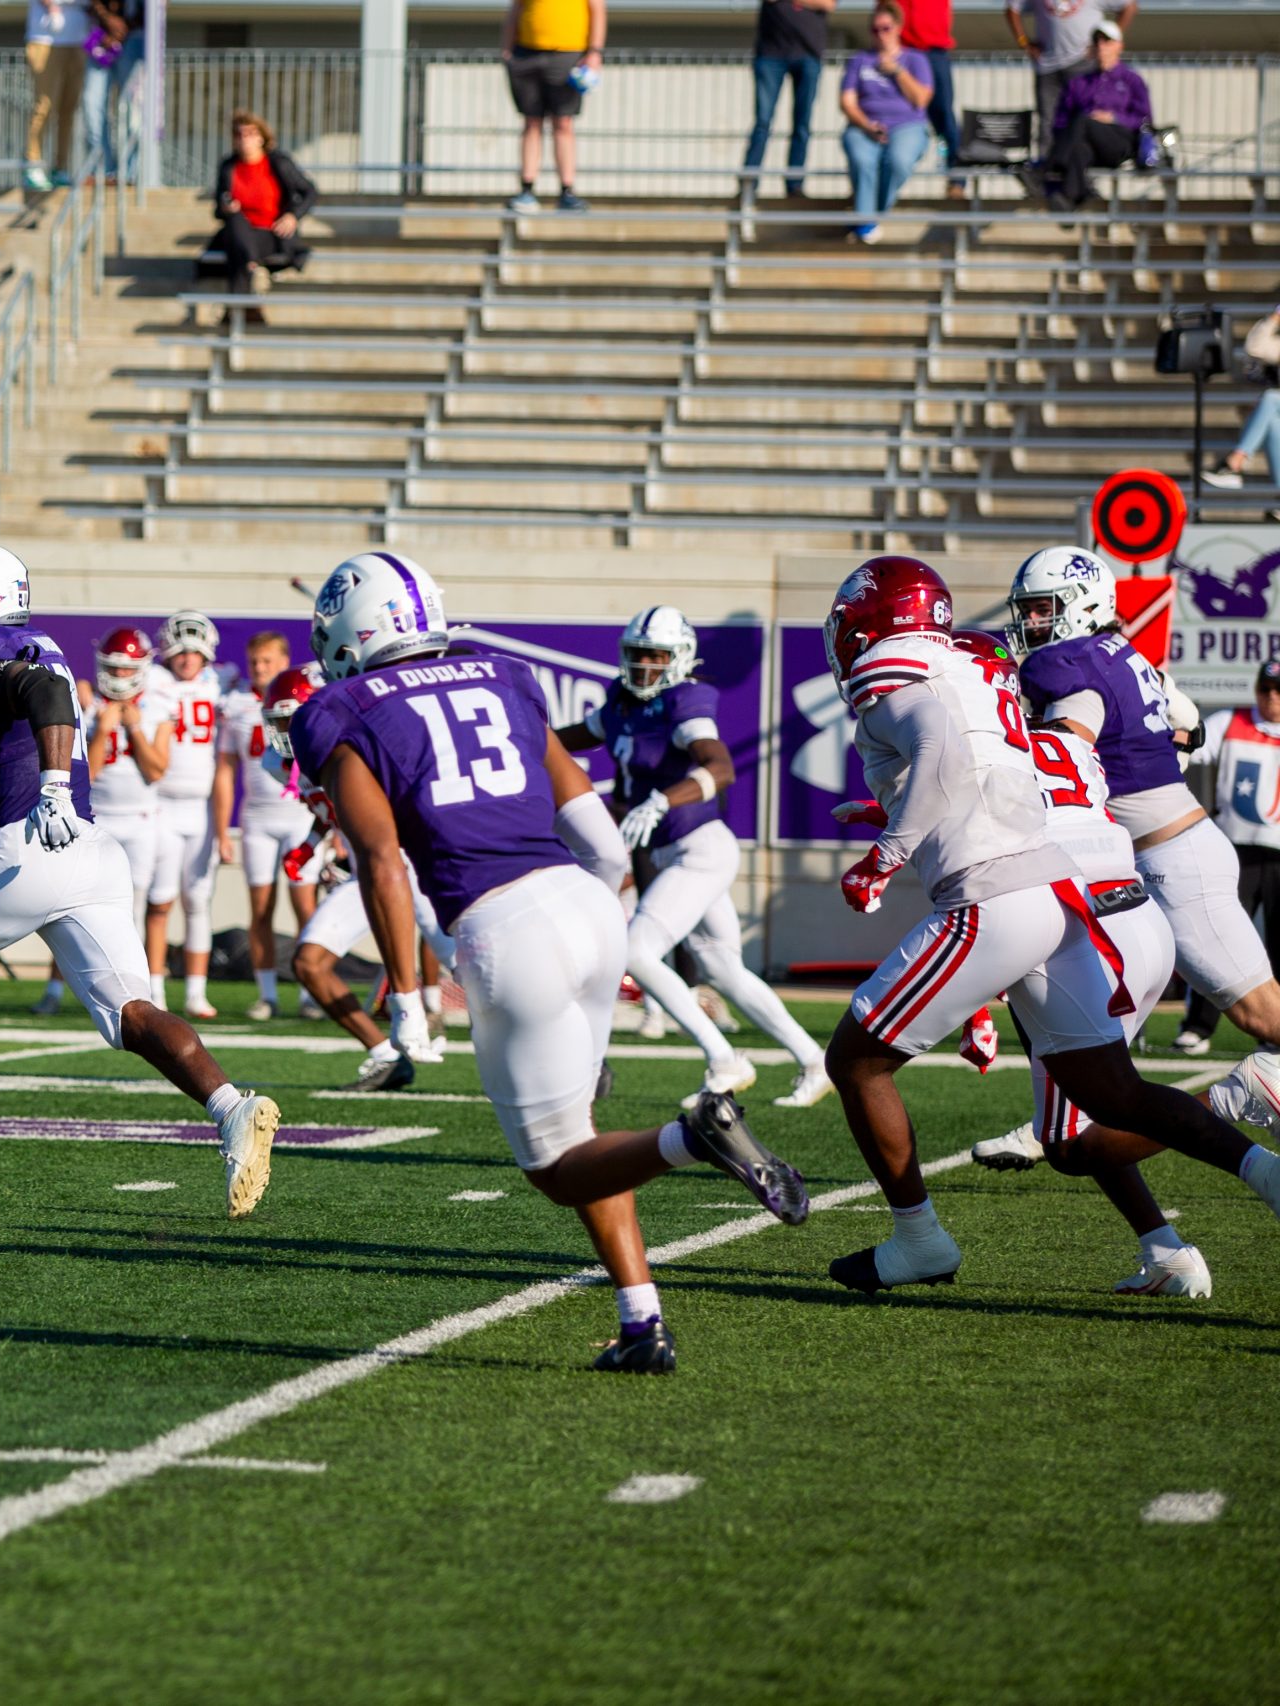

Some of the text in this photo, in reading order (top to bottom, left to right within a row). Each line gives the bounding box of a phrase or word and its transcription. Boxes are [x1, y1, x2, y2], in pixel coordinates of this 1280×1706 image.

[1198, 628, 1280, 662] PURP
[365, 661, 497, 697] D. DUDLEY
[404, 687, 527, 807] 13
[1029, 731, 1094, 809] 9
